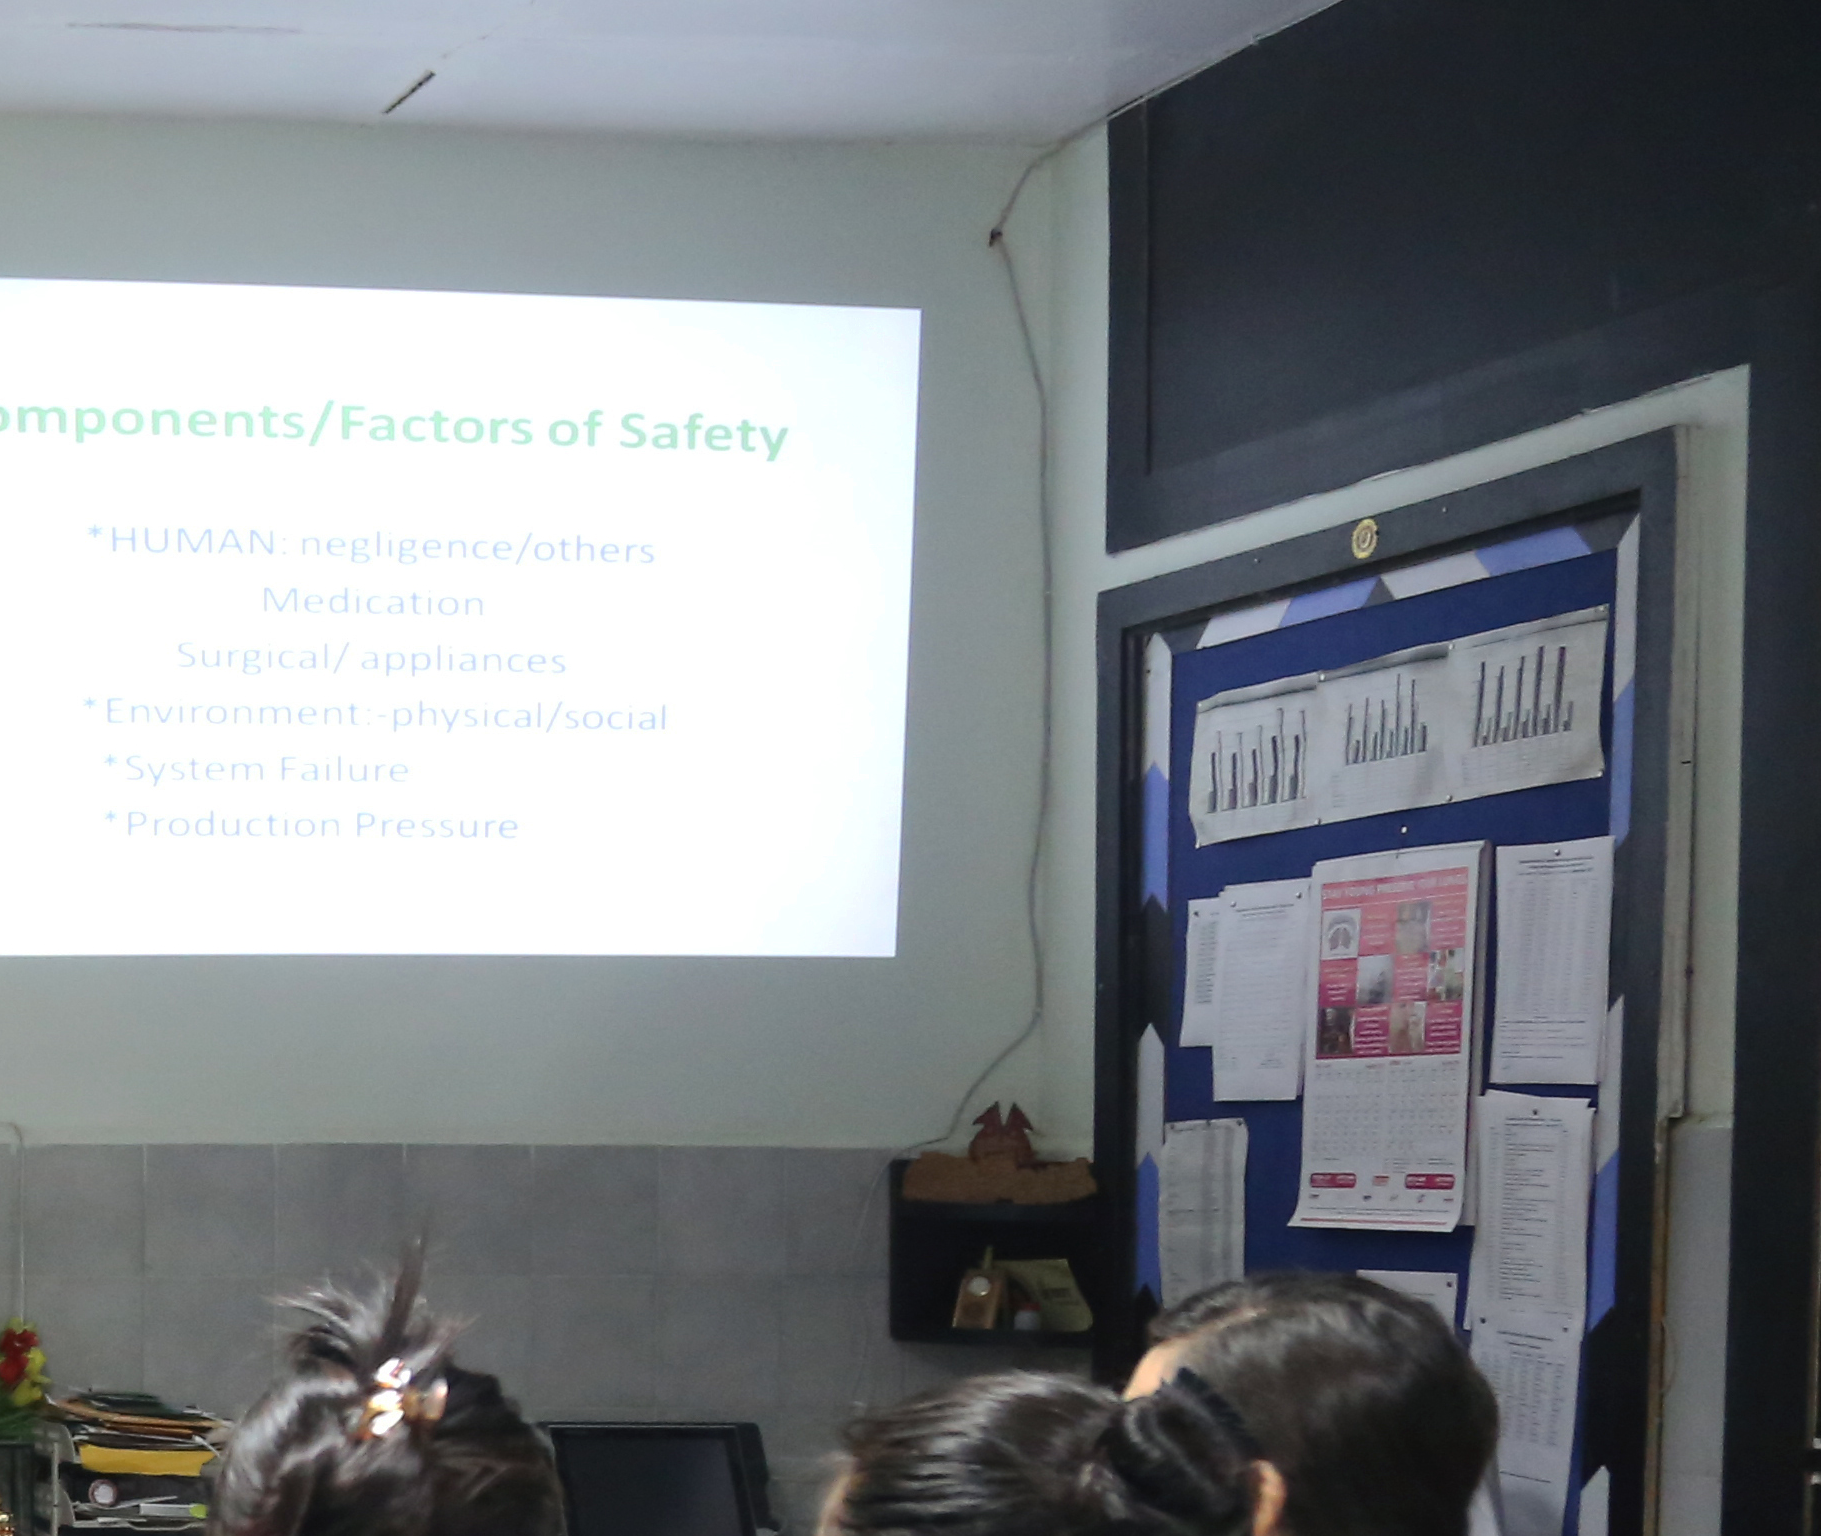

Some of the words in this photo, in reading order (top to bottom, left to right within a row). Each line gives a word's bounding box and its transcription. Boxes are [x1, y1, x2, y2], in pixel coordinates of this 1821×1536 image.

[547, 407, 605, 448] of
[618, 410, 791, 464] Safety
[301, 530, 656, 566] negligence/others
[263, 586, 484, 617] Medication
[177, 641, 350, 676] Surgical/
[360, 644, 567, 678] appliances
[280, 755, 410, 783] Failure
[356, 811, 519, 840] Pressure
